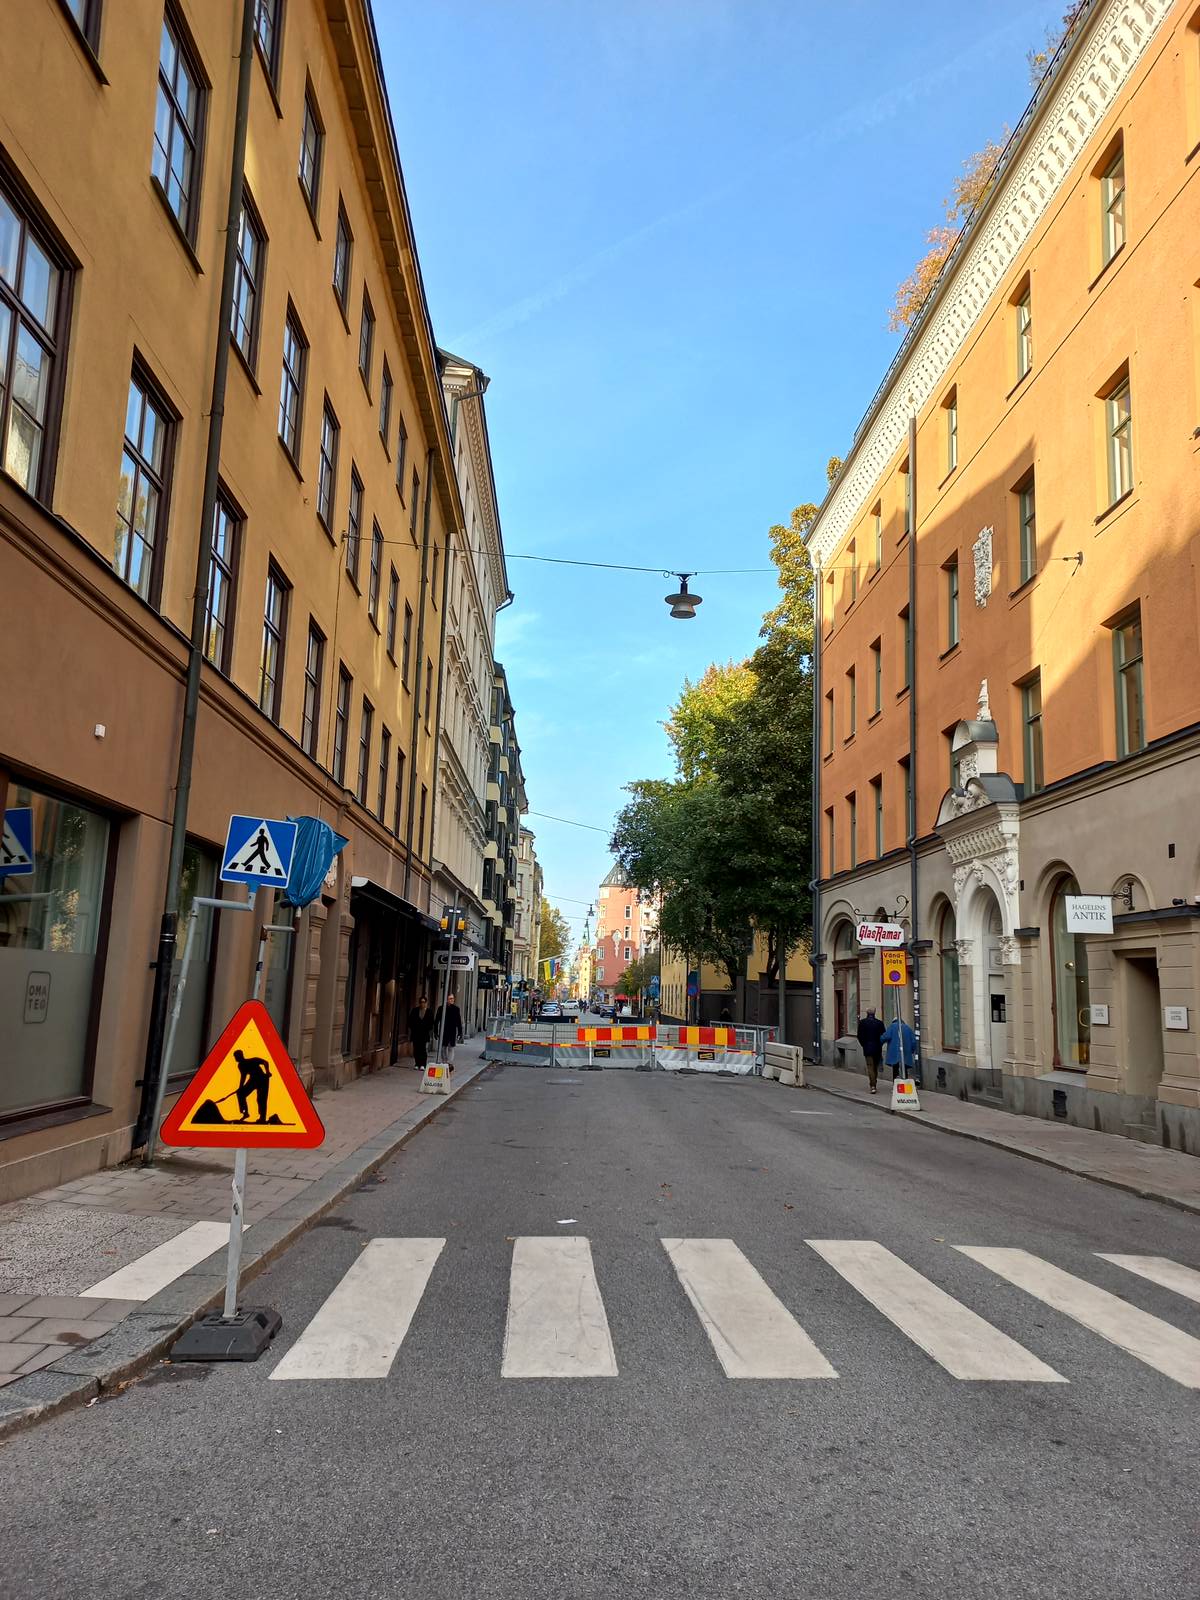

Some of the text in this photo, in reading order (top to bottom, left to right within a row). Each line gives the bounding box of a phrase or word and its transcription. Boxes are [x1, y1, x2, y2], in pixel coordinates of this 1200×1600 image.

[1073, 911, 1106, 920] ANTIK
[859, 925, 902, 942] GlasRamar
[30, 985, 47, 997] OMA
